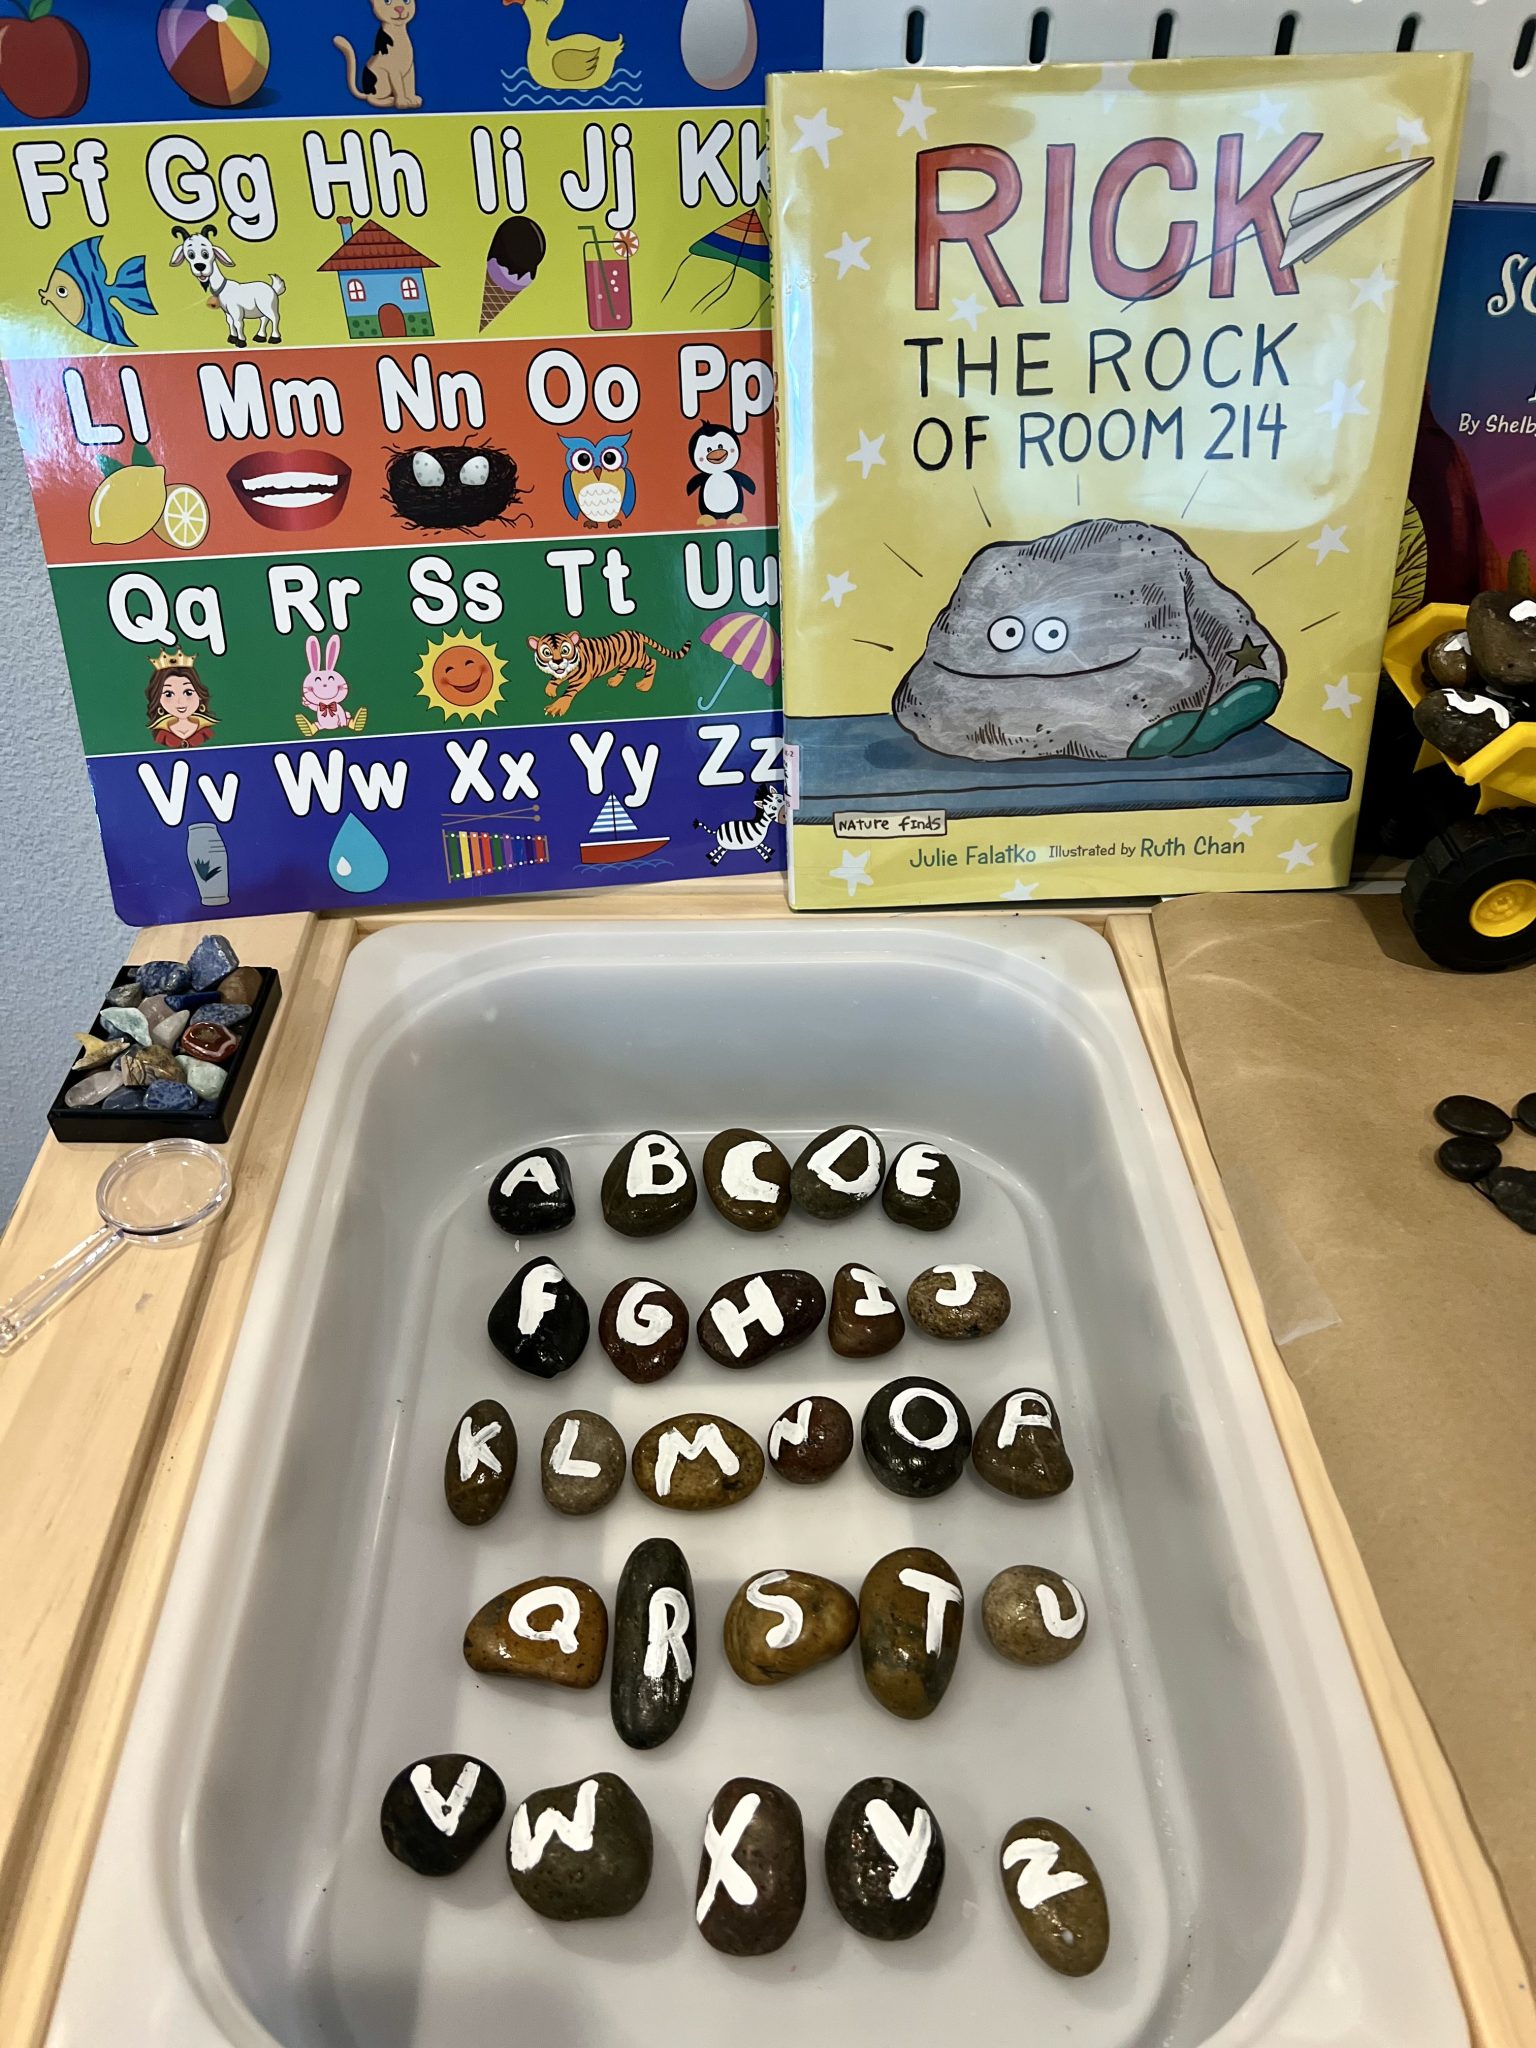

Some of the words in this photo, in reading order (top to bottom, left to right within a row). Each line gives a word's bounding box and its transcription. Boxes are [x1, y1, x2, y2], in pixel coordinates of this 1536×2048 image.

[12, 137, 110, 229] Ff
[145, 133, 280, 242] Gg
[302, 128, 428, 219] Hh
[470, 125, 530, 215] Ii
[559, 123, 638, 231] Jj
[914, 131, 1325, 312] RICK
[61, 365, 152, 446] Ll
[197, 360, 346, 440] Mm
[376, 353, 488, 433] Nn
[525, 348, 642, 426] Oo
[678, 342, 774, 435] Pp
[903, 331, 1054, 399] THE
[1087, 322, 1299, 395] ROCK
[912, 414, 992, 472] OF
[1018, 406, 1184, 470] ROOM
[1203, 402, 1288, 461] 214
[1458, 412, 1481, 436] By
[1485, 414, 1536, 438] Shelb
[105, 571, 227, 656] Qq
[266, 563, 362, 635] Rr
[406, 554, 504, 627] Ss
[544, 546, 638, 619] Tt
[682, 539, 780, 612] Uu
[136, 758, 241, 828] Vv
[272, 747, 410, 818] Ww
[445, 737, 541, 806] Xx
[567, 729, 661, 809] Yy
[696, 722, 785, 788] Zz
[909, 848, 958, 868] Julie
[965, 844, 1037, 866] Falatko
[1049, 843, 1116, 858] Illustrated
[1120, 843, 1137, 858] by
[1140, 837, 1186, 857] Ruth
[1193, 836, 1245, 856] Chan
[499, 1155, 561, 1198] A
[625, 1134, 689, 1198] B
[719, 1139, 781, 1204] C
[805, 1127, 882, 1198] D
[892, 1143, 945, 1199] E
[516, 1263, 565, 1337] F
[614, 1281, 675, 1347] G
[708, 1275, 786, 1359] H
[848, 1267, 897, 1318] I
[931, 1263, 987, 1308] J
[457, 1416, 503, 1482] K
[548, 1418, 603, 1479] L
[653, 1421, 742, 1498] M
[769, 1399, 814, 1461] N
[887, 1386, 960, 1452] O
[507, 1584, 582, 1656] Q
[642, 1586, 692, 1684] R
[745, 1570, 805, 1650] S
[897, 1567, 963, 1657] T
[1034, 1578, 1087, 1640] U
[408, 1760, 482, 1837] V
[509, 1778, 600, 1873] W
[694, 1791, 762, 1926] X
[862, 1797, 933, 1901] Y
[1001, 1836, 1090, 1911] Z
